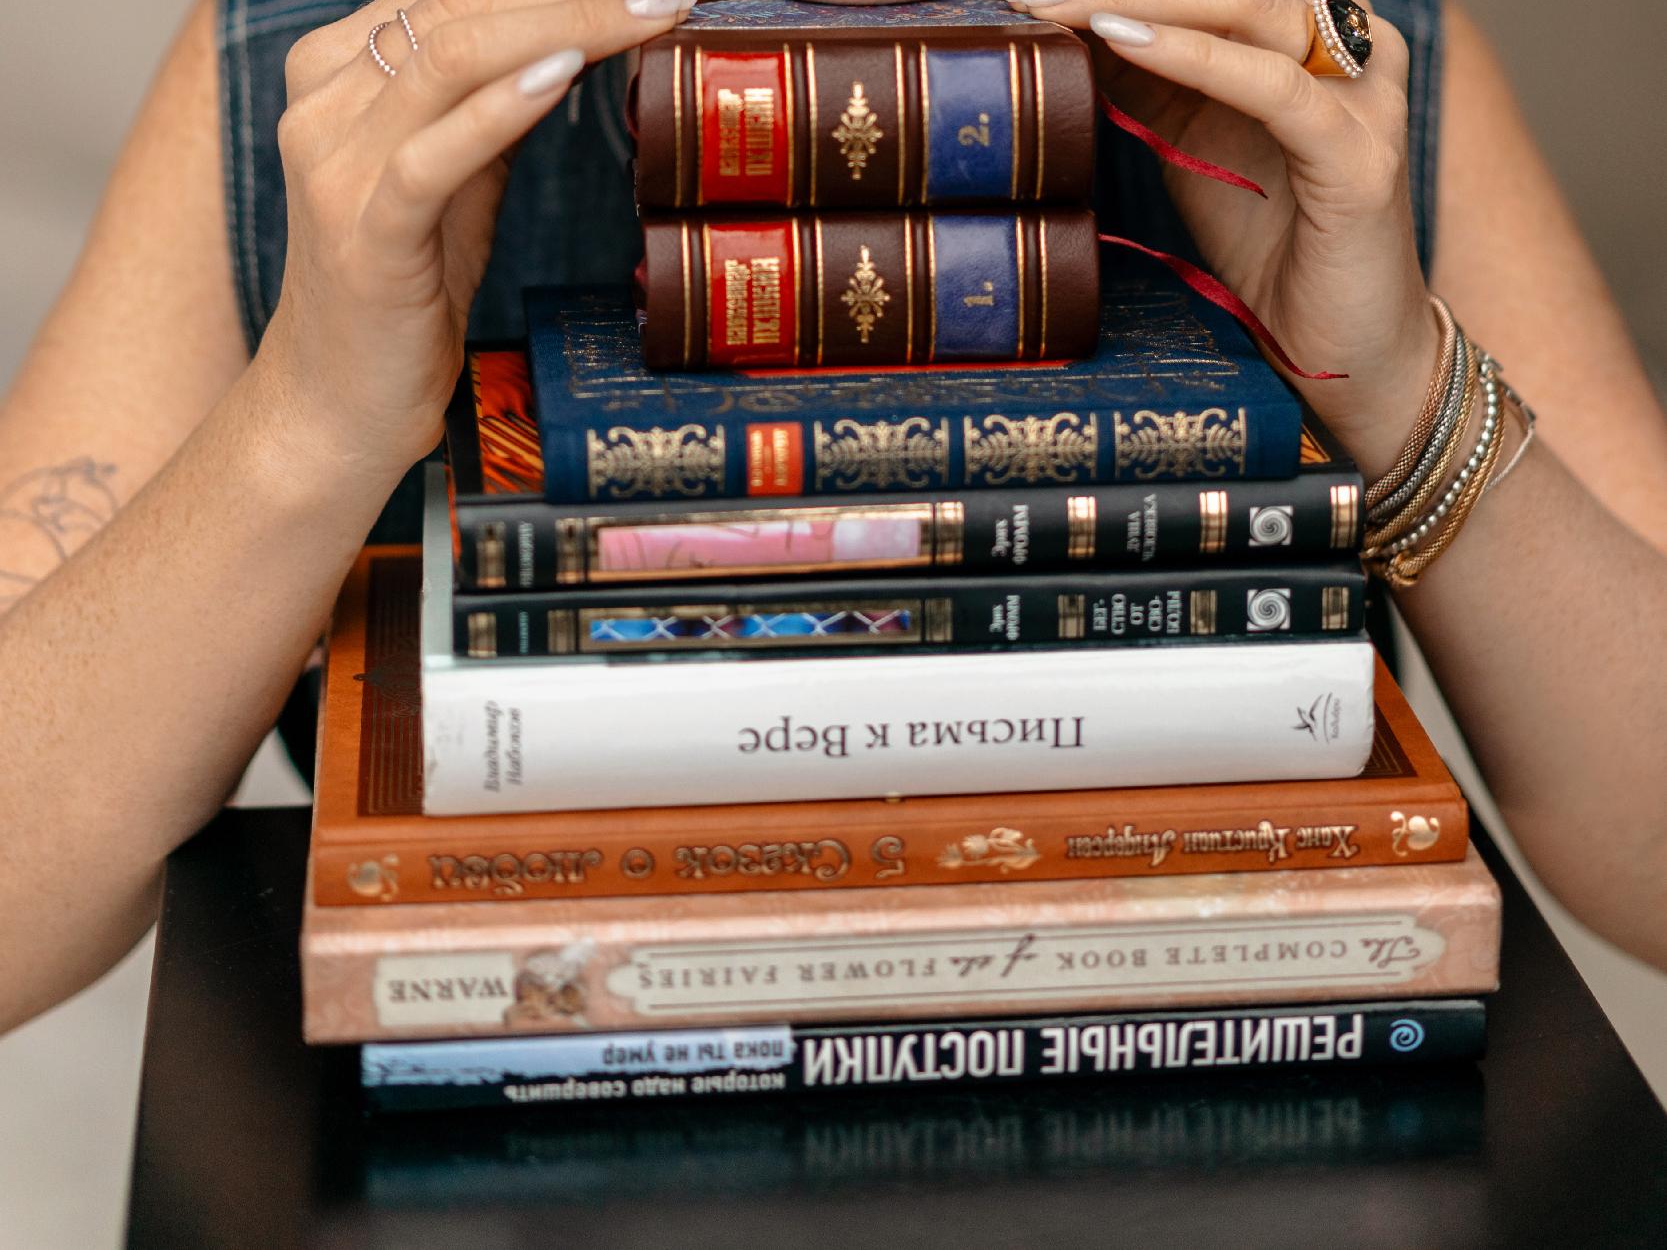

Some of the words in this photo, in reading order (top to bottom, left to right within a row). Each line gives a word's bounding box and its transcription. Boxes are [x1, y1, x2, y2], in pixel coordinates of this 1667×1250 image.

[957, 113, 990, 146] 2.
[751, 257, 780, 344] ПУШКИН
[964, 281, 993, 307] 1.
[1012, 505, 1029, 564] ФРОММ
[1127, 511, 1140, 552] ДУША
[1143, 494, 1157, 560] ЧЕЛОВЕКА
[1006, 595, 1020, 640] ФРОММ
[1111, 594, 1125, 634] СТВО
[1130, 603, 1144, 625] ОТ
[737, 715, 850, 757] Вере
[865, 723, 890, 748] к
[907, 716, 1085, 749] Письма
[1067, 824, 1178, 867] Андерсен
[1181, 820, 1291, 861] Кристиан
[1296, 823, 1358, 859] Ханс
[673, 839, 851, 885] Сказок
[870, 835, 905, 880] 5
[948, 956, 993, 976] the
[1001, 934, 1037, 977] of
[1056, 949, 1146, 971] BOOK
[1165, 940, 1346, 966] COMPLETE
[1360, 937, 1420, 968] The
[638, 963, 777, 989] FAIRIES
[798, 958, 936, 982] FLOWER
[388, 976, 507, 1003] WARNE
[603, 1041, 654, 1067] умер
[665, 1046, 688, 1064] не
[697, 1045, 725, 1066] ты
[733, 1040, 784, 1064] пока
[803, 1030, 1025, 1085] ПОСТУПКИ
[1041, 1013, 1364, 1073] РЕШИТЕЛЬНЫЕ
[504, 1078, 627, 1101] совершить
[633, 1077, 686, 1096] надо
[691, 1070, 785, 1094] которые
